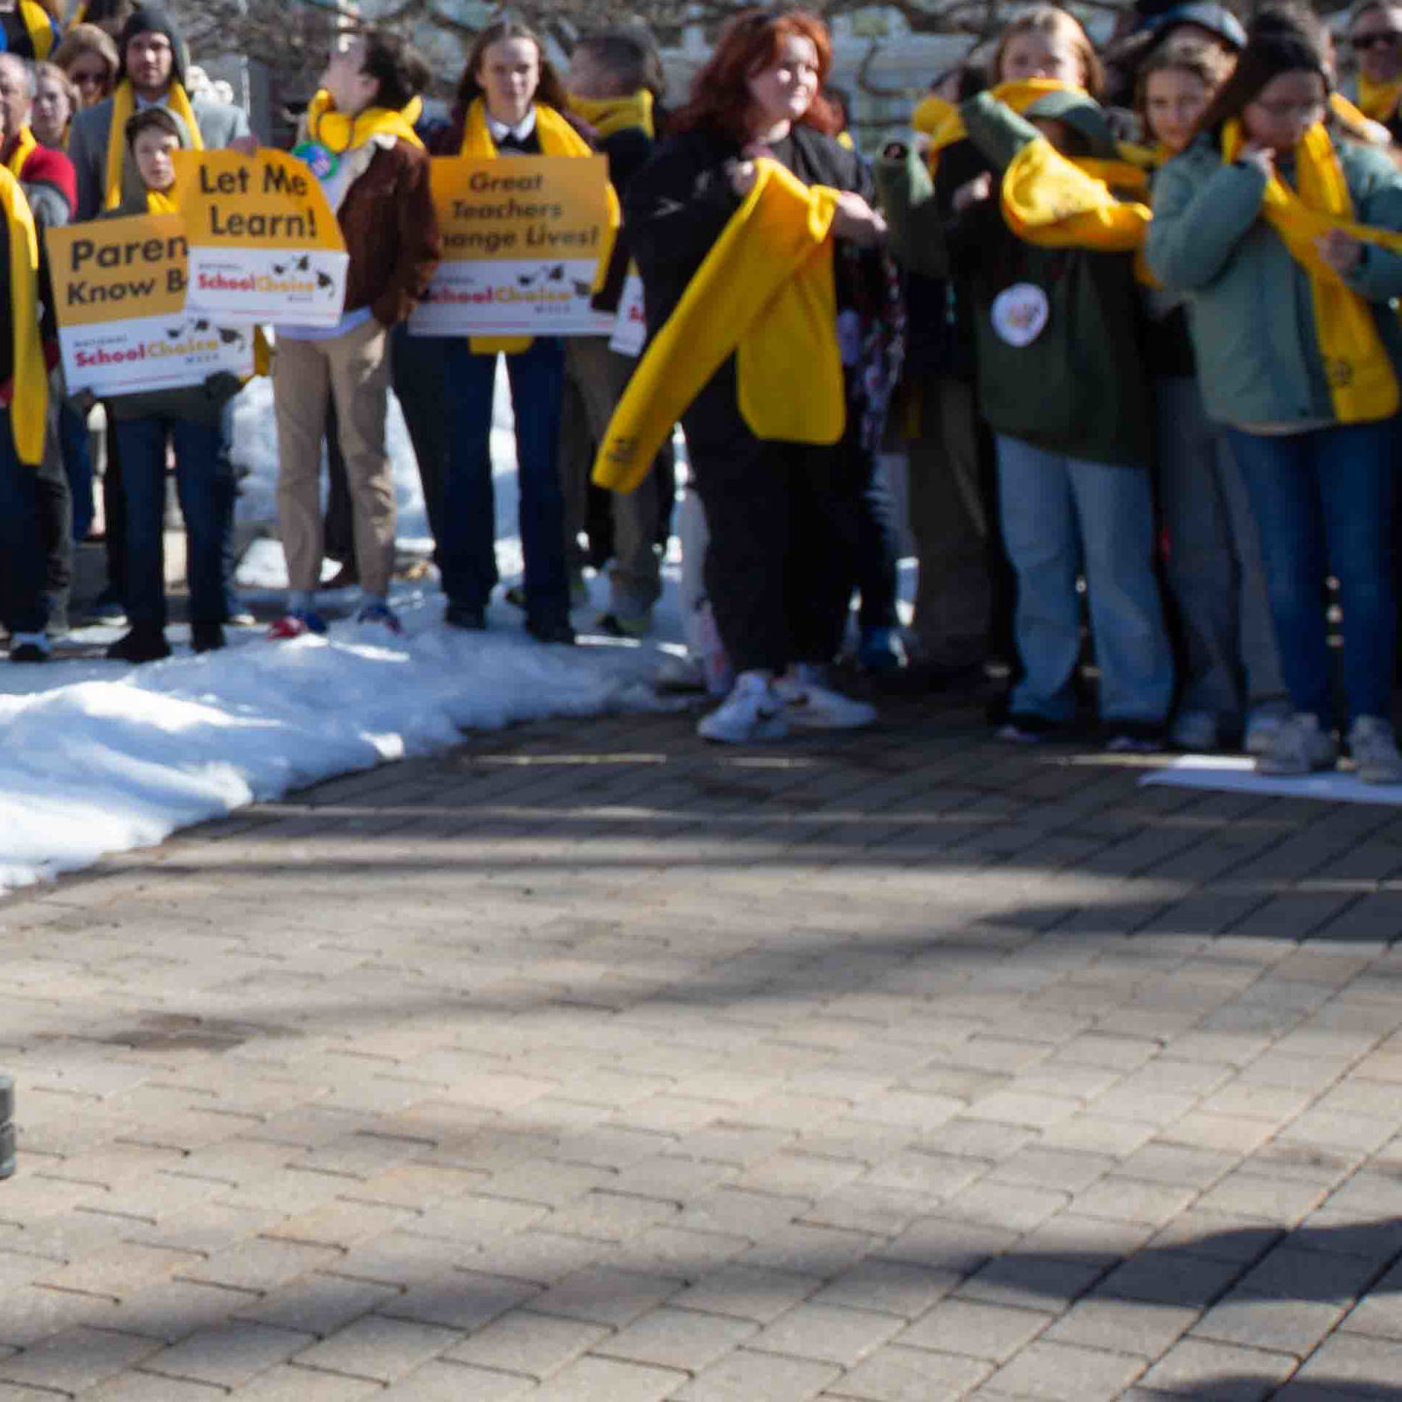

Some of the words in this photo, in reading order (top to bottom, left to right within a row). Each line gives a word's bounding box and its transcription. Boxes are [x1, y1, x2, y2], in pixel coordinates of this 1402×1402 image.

[199, 163, 250, 195] Let
[262, 163, 308, 196] Me
[468, 172, 544, 192] Great
[210, 204, 318, 238] Learn!
[451, 199, 563, 220] Teachers
[70, 235, 188, 271] Paren
[441, 229, 517, 253] ange
[525, 225, 600, 247] Lives!
[67, 278, 156, 306] Know
[429, 286, 574, 304] choolChoice
